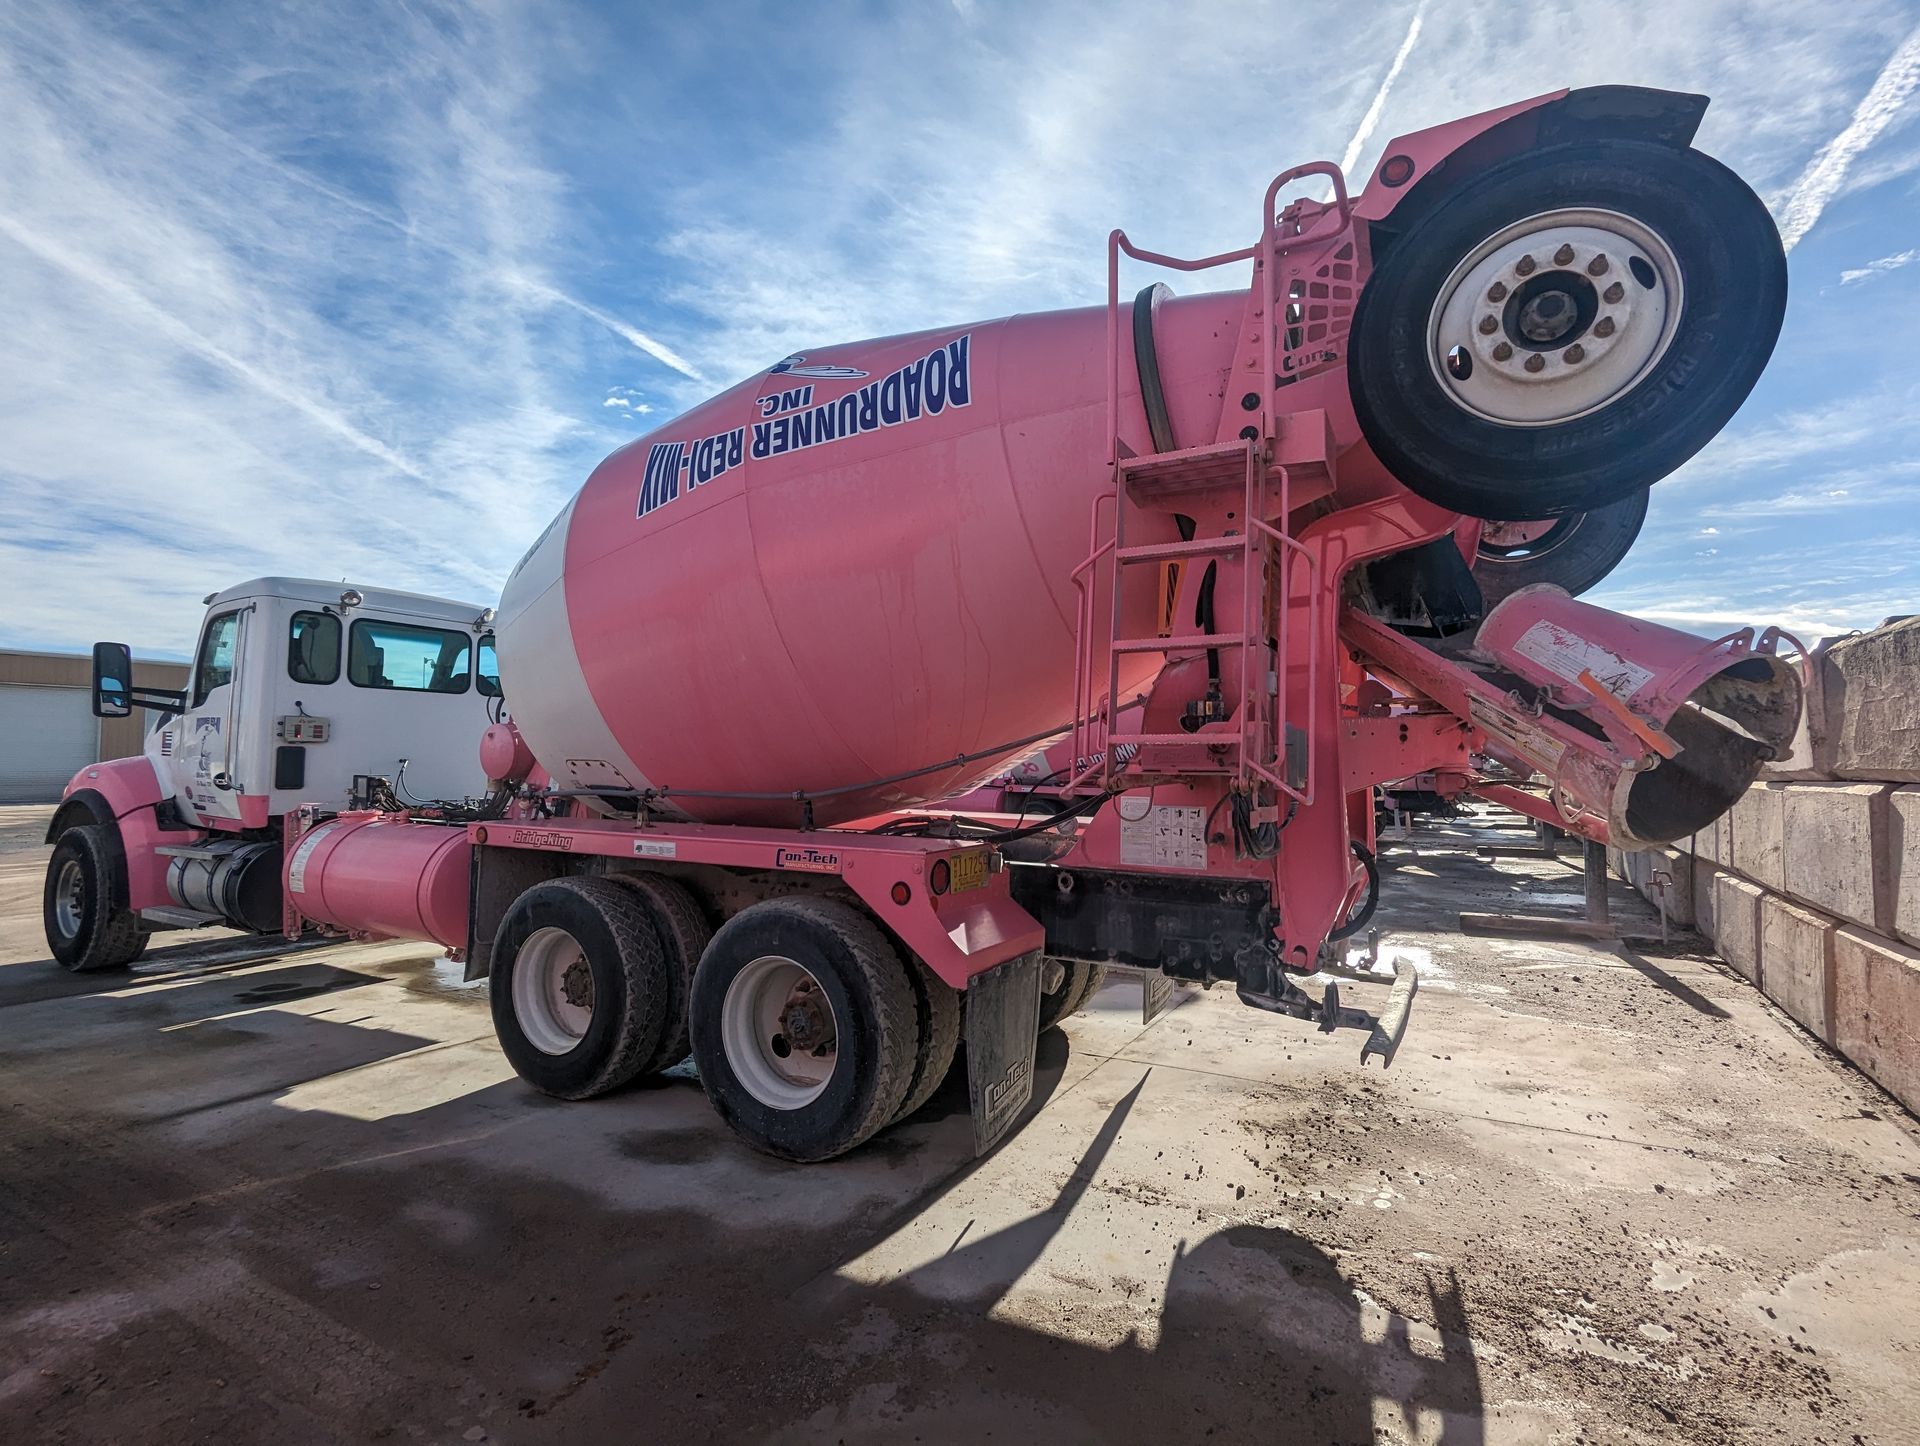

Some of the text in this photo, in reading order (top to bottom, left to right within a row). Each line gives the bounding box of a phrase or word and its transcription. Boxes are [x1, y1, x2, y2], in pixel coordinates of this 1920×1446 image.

[756, 384, 815, 417] INC.
[636, 334, 972, 519] ROADRUNNER REDI-MIX
[513, 830, 573, 850] BridgeKing
[776, 848, 838, 868] Con-Tech
[958, 854, 988, 877] 117259
[985, 1057, 1031, 1120] Con-Tech
